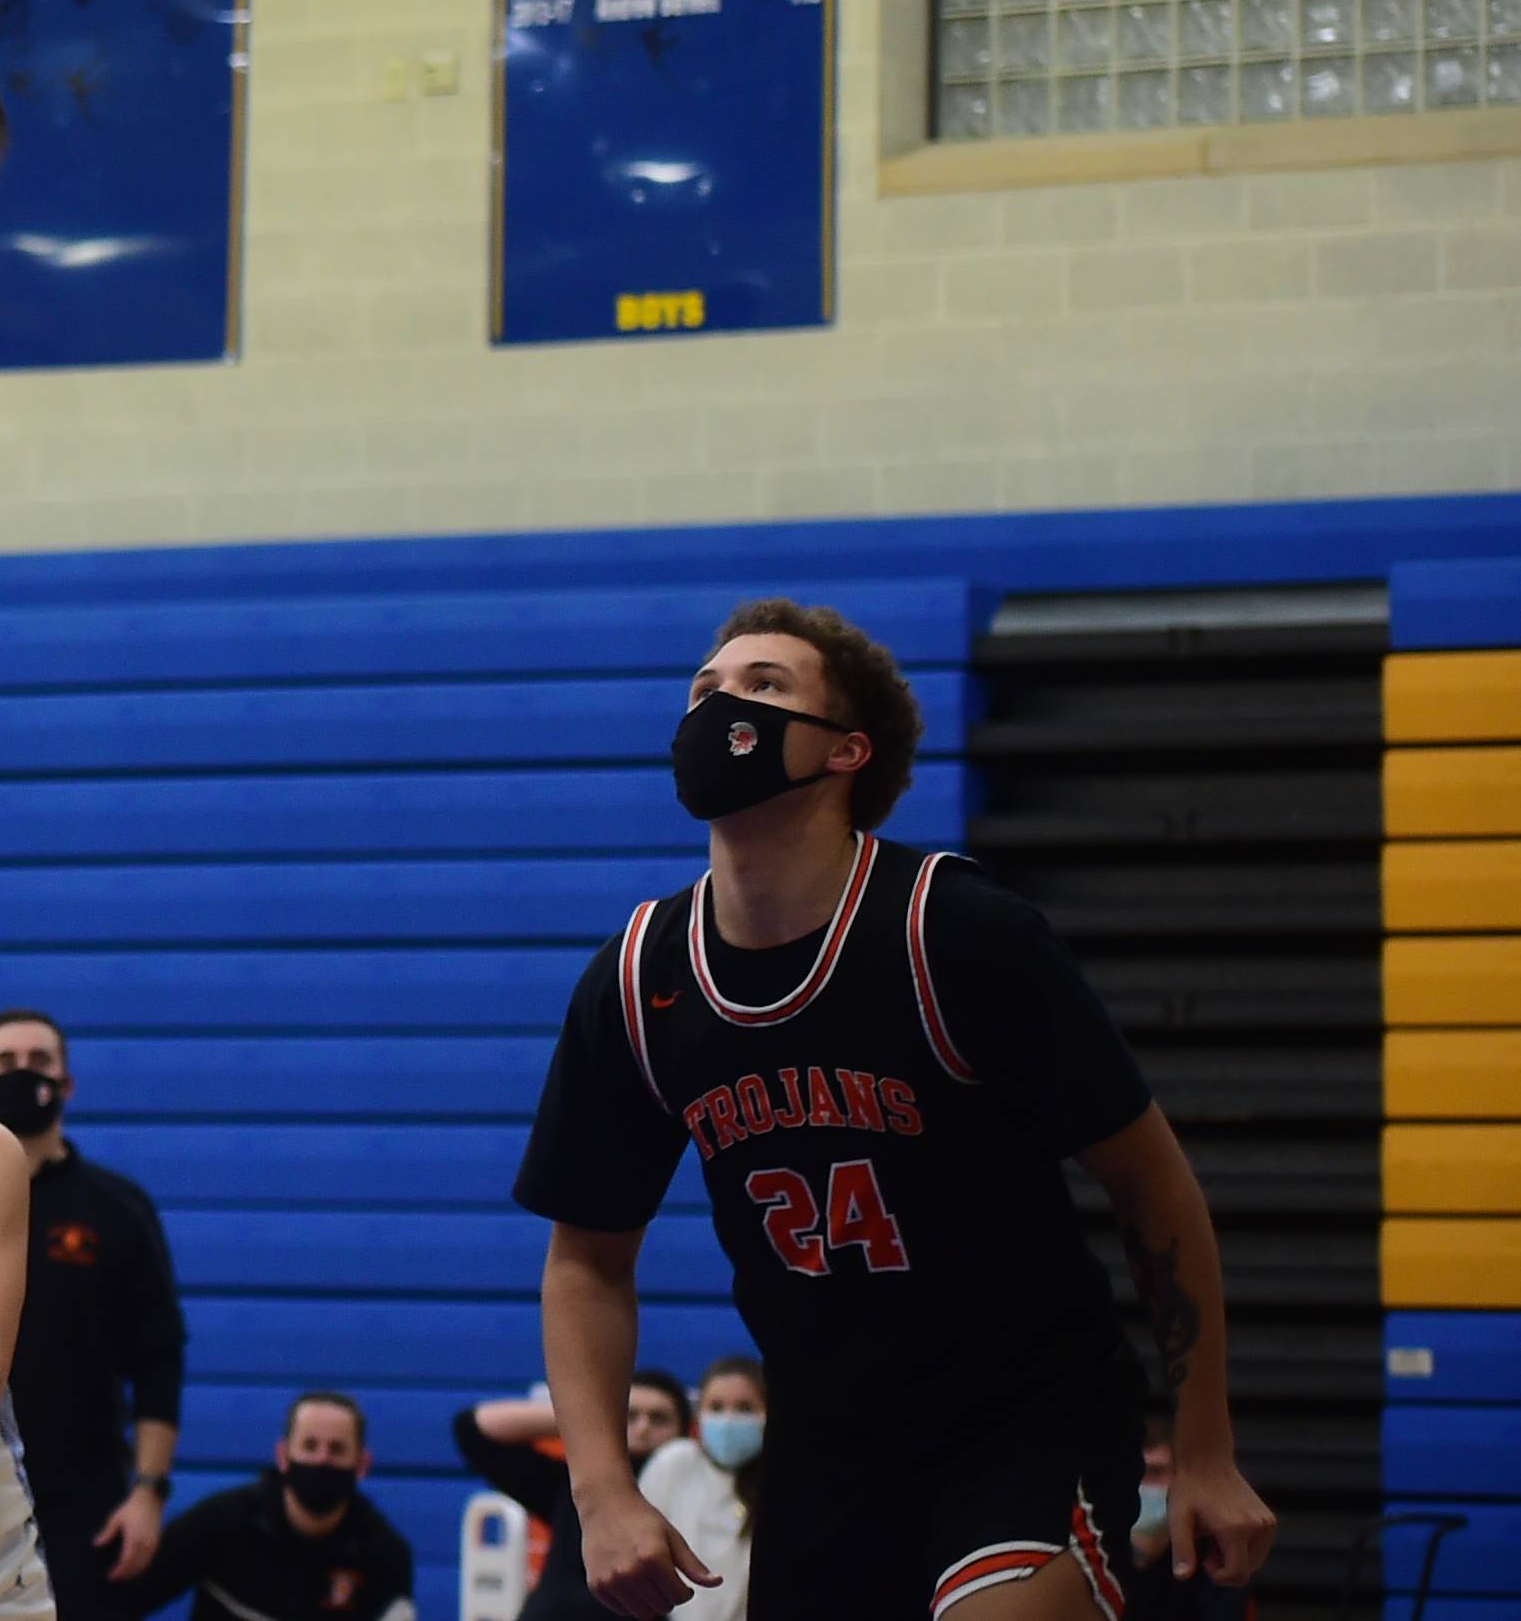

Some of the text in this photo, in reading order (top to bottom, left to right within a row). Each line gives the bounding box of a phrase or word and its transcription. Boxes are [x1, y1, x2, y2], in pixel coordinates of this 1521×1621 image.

[616, 290, 705, 331] BOYS
[682, 1066, 924, 1162] TROJANS
[745, 1158, 911, 1277] 24
